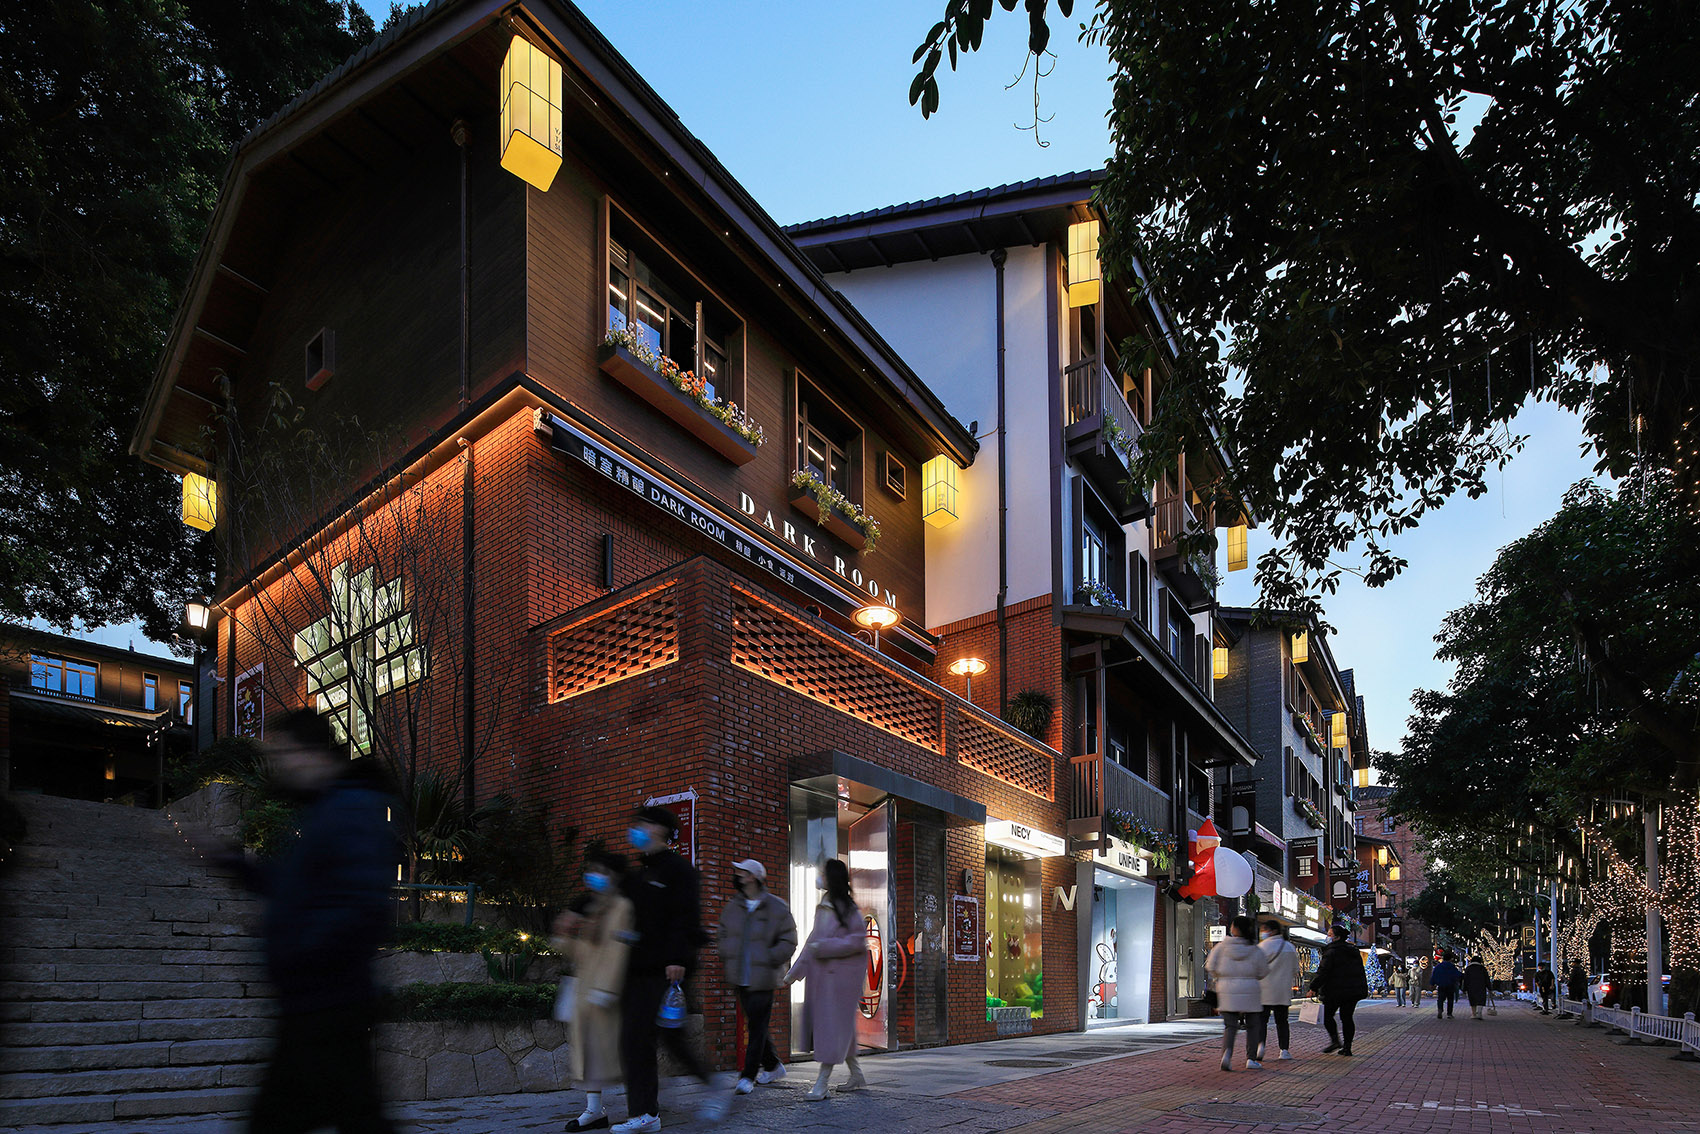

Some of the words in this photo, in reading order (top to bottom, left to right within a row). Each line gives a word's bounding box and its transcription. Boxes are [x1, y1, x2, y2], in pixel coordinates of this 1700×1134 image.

[651, 487, 686, 518] DARK
[691, 511, 726, 541] ROOM
[740, 491, 817, 558] DARK
[835, 555, 897, 608] ROOM
[1011, 823, 1031, 840] NECY
[1118, 852, 1140, 872] UNIFINE
[1050, 885, 1078, 912] N
